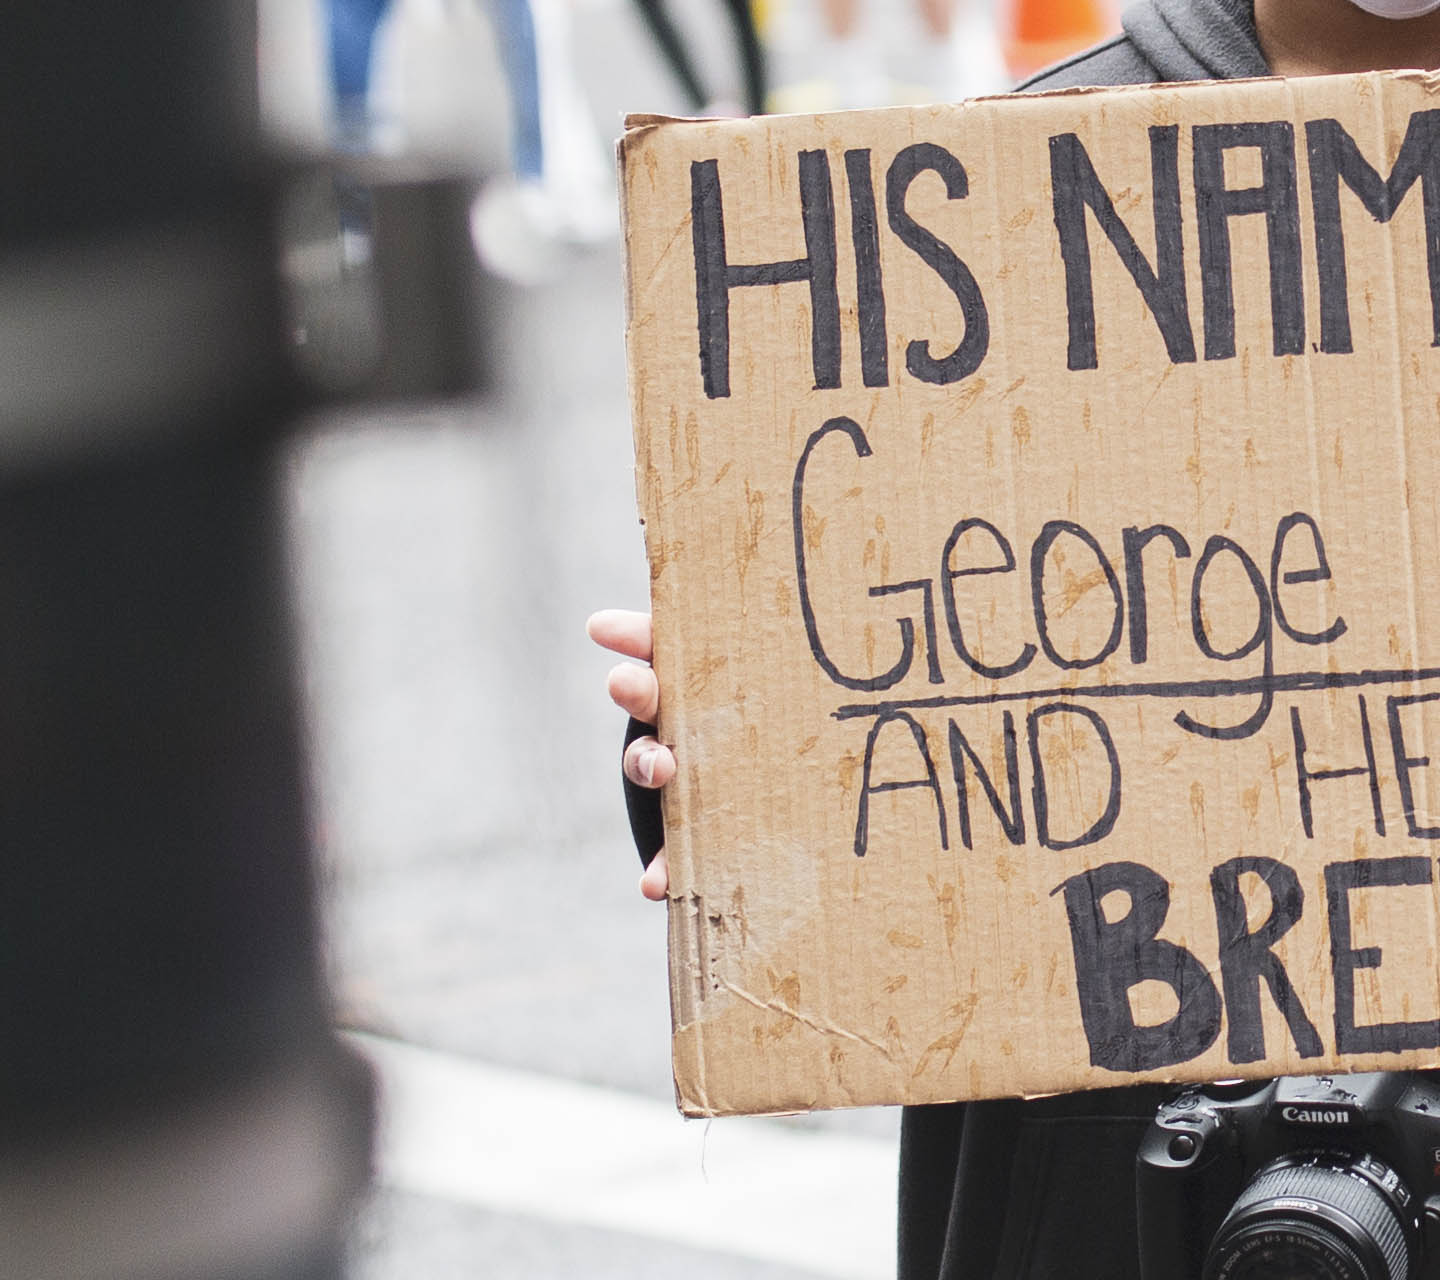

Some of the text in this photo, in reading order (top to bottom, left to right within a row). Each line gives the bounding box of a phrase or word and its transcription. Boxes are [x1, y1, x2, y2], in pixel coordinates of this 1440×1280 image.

[690, 141, 991, 400] HIS
[792, 416, 1349, 742] George
[853, 702, 1122, 858] AND
[1281, 1106, 1350, 1124] Canon
